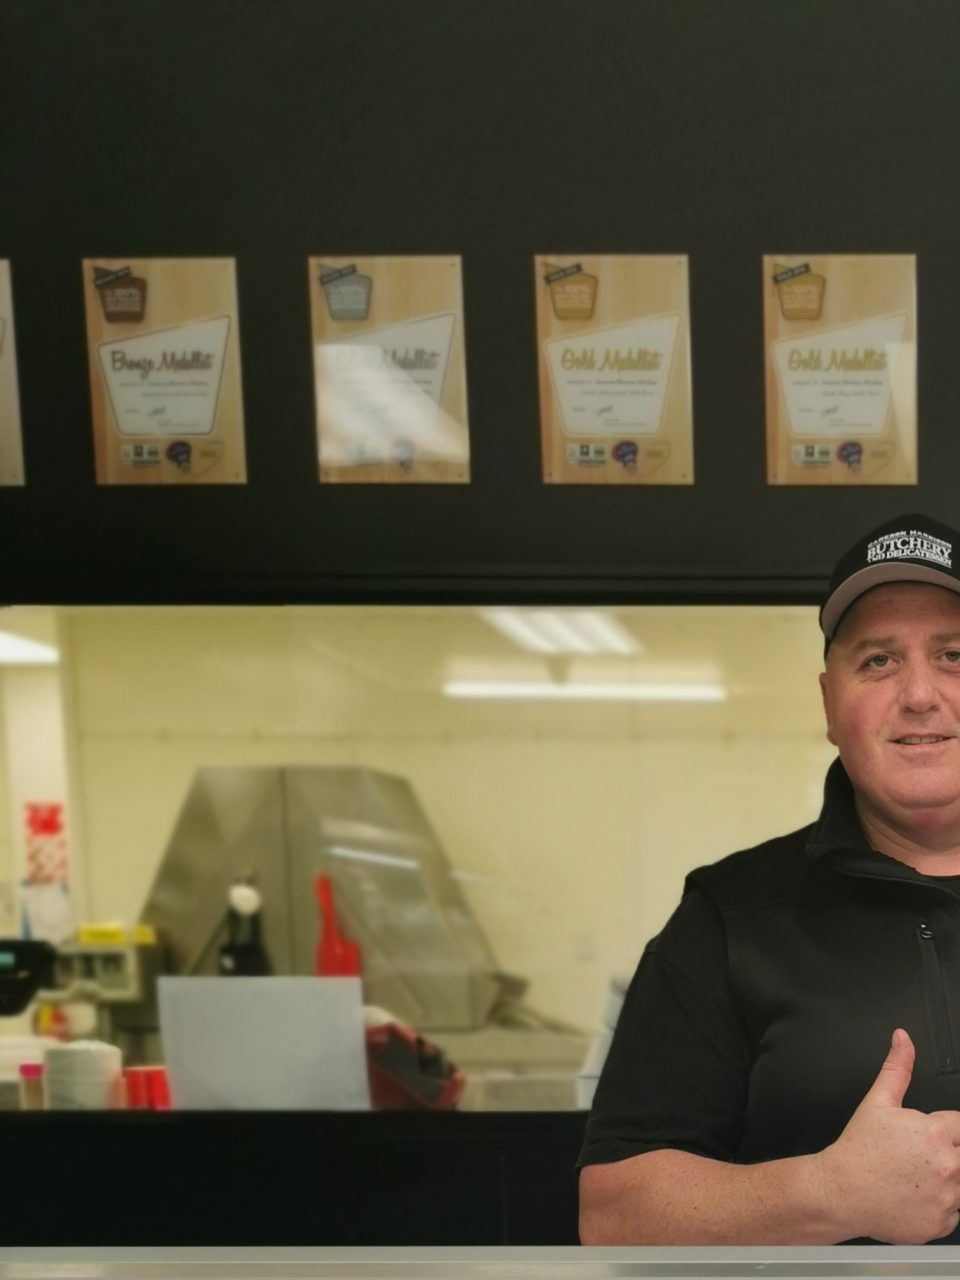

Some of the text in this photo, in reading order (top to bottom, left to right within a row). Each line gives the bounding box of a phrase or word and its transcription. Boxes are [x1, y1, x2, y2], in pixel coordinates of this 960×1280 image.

[111, 350, 154, 379] Bronze
[561, 349, 596, 370] Gold
[788, 349, 822, 371] Gold
[868, 537, 952, 559] BUTCHERY
